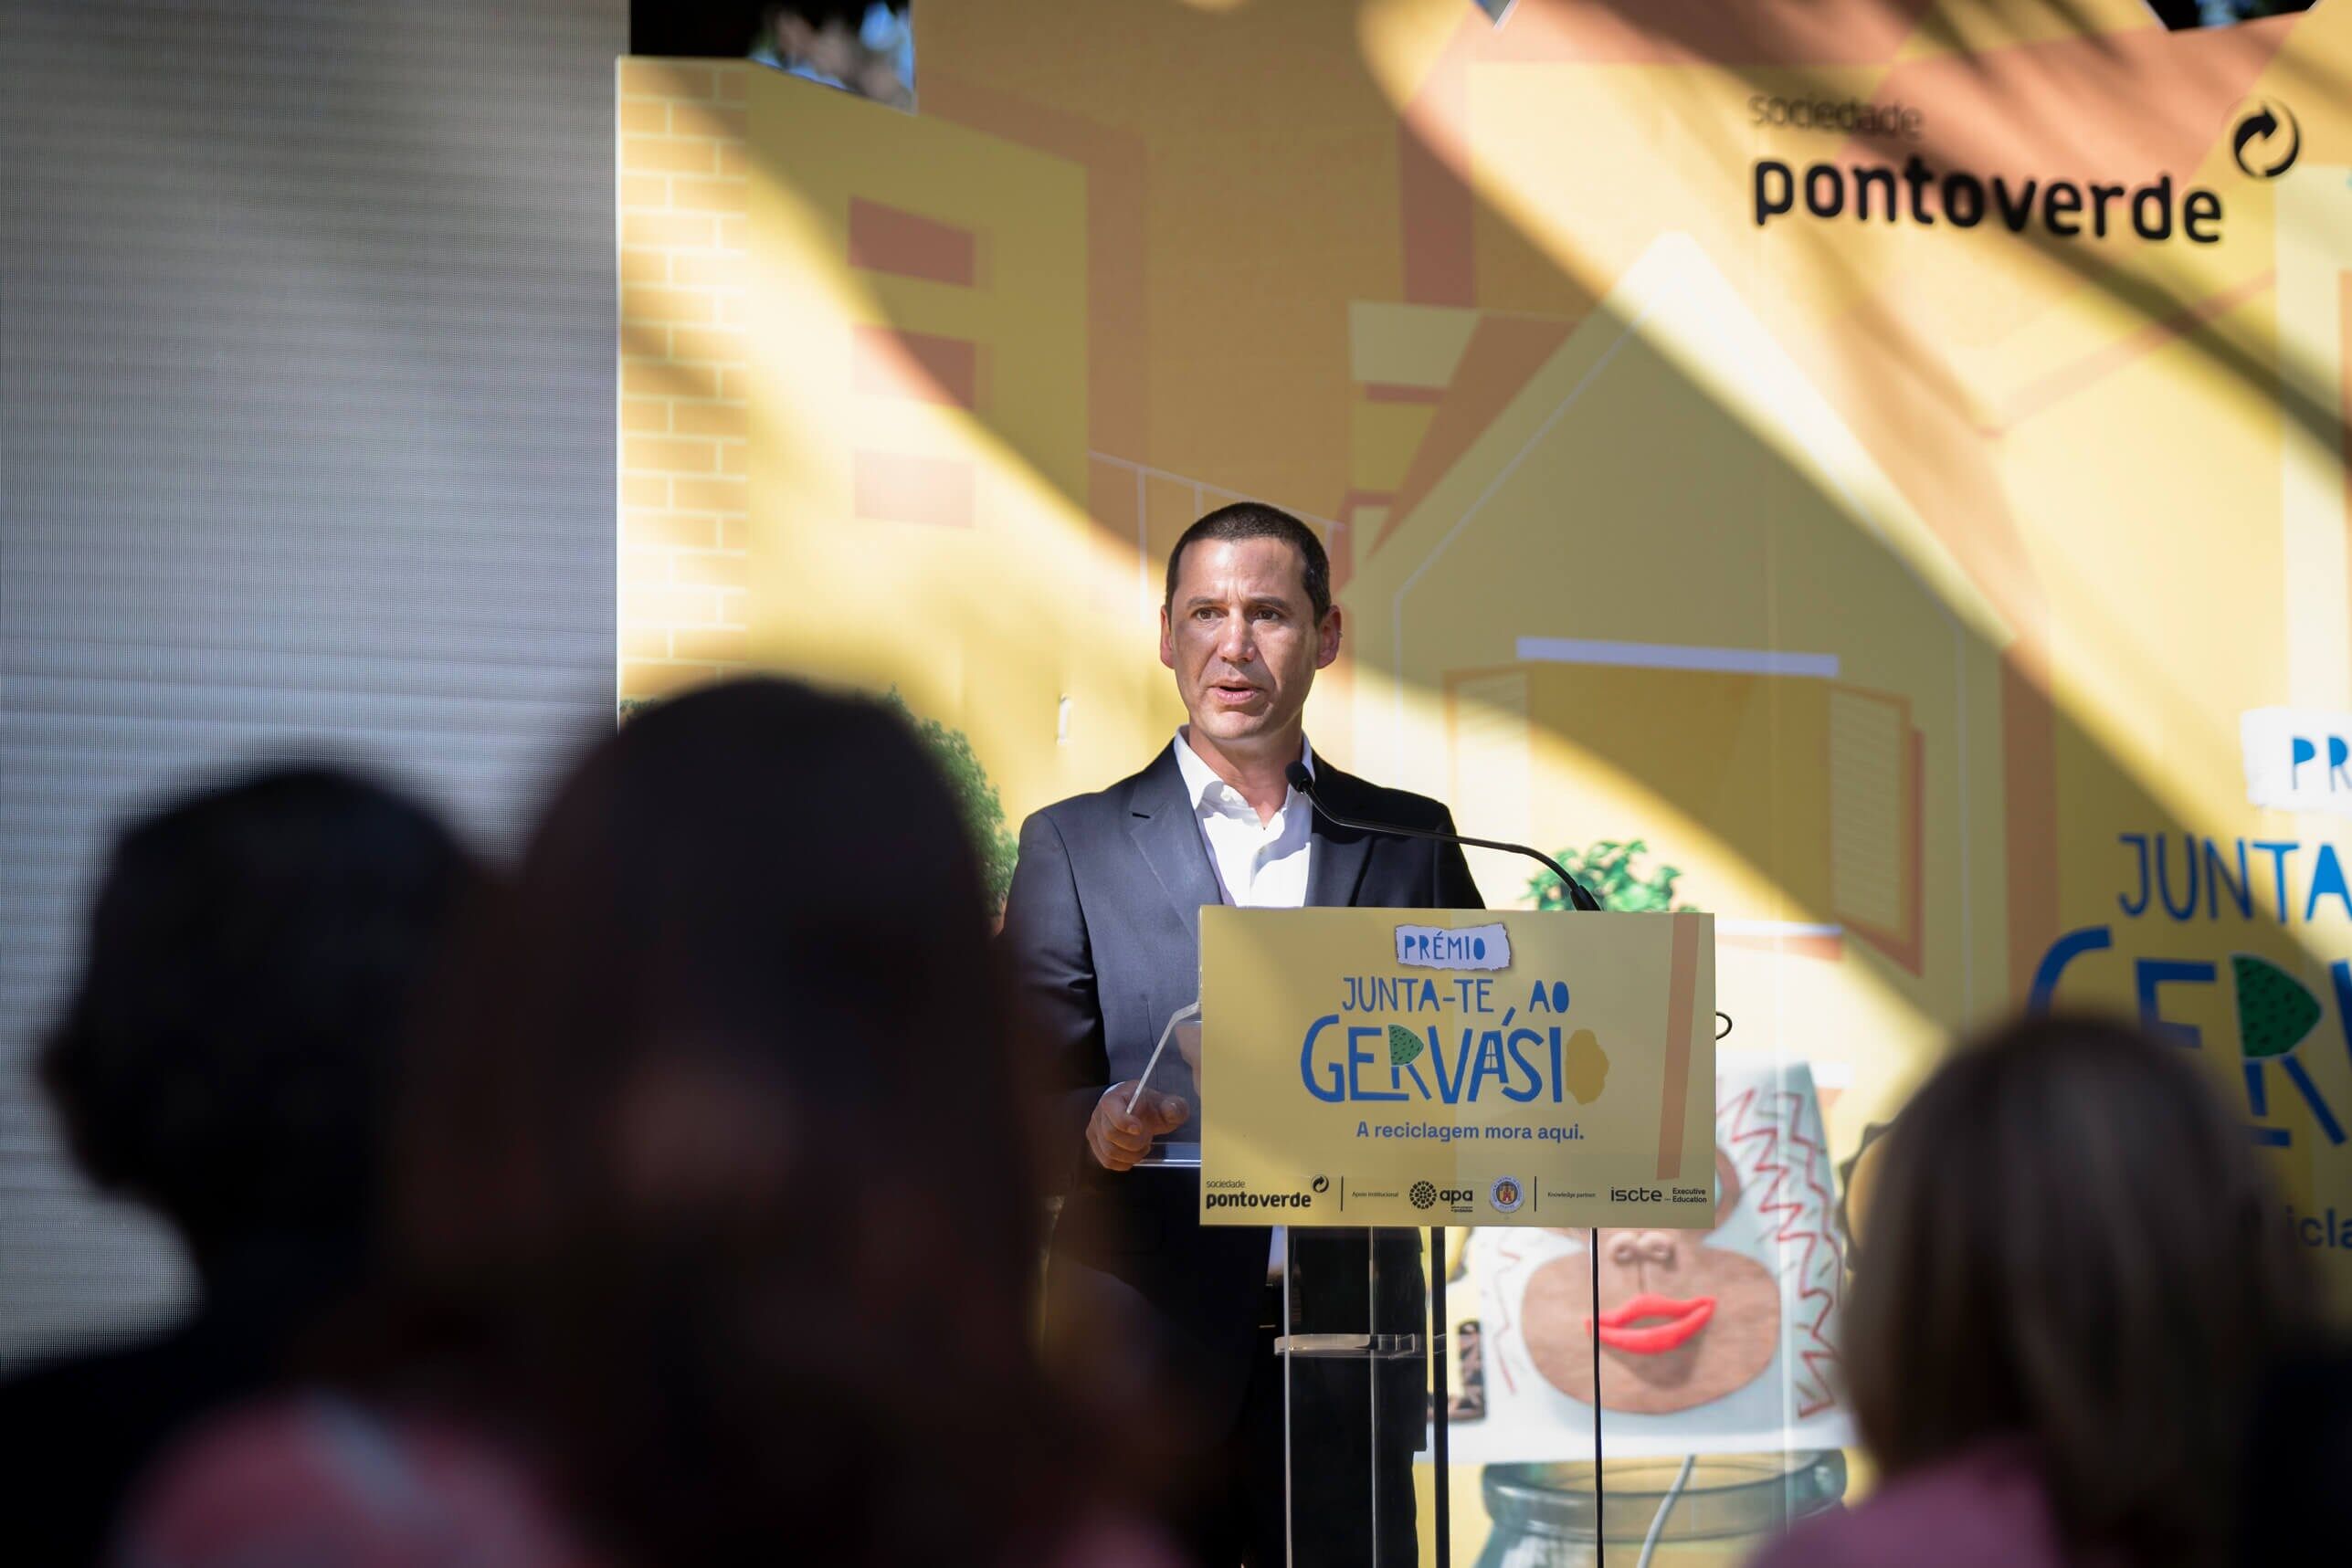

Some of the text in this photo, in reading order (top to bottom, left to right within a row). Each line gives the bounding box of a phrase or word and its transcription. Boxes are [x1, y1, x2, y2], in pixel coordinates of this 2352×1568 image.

[1749, 95, 1925, 137] sociedade
[1754, 155, 2223, 244] pontoverde
[1404, 931, 1486, 961] PRÉMIO
[1342, 977, 1569, 1013] JUNTA-TE AO
[1356, 1121, 1585, 1143] A reciclagem mora aqui.
[1206, 1179, 1245, 1188] sociedade
[1206, 1192, 1312, 1209] pontoverde
[1440, 1190, 1473, 1205] apa
[1610, 1186, 1662, 1203] iscte
[1672, 1195, 1707, 1204] Education
